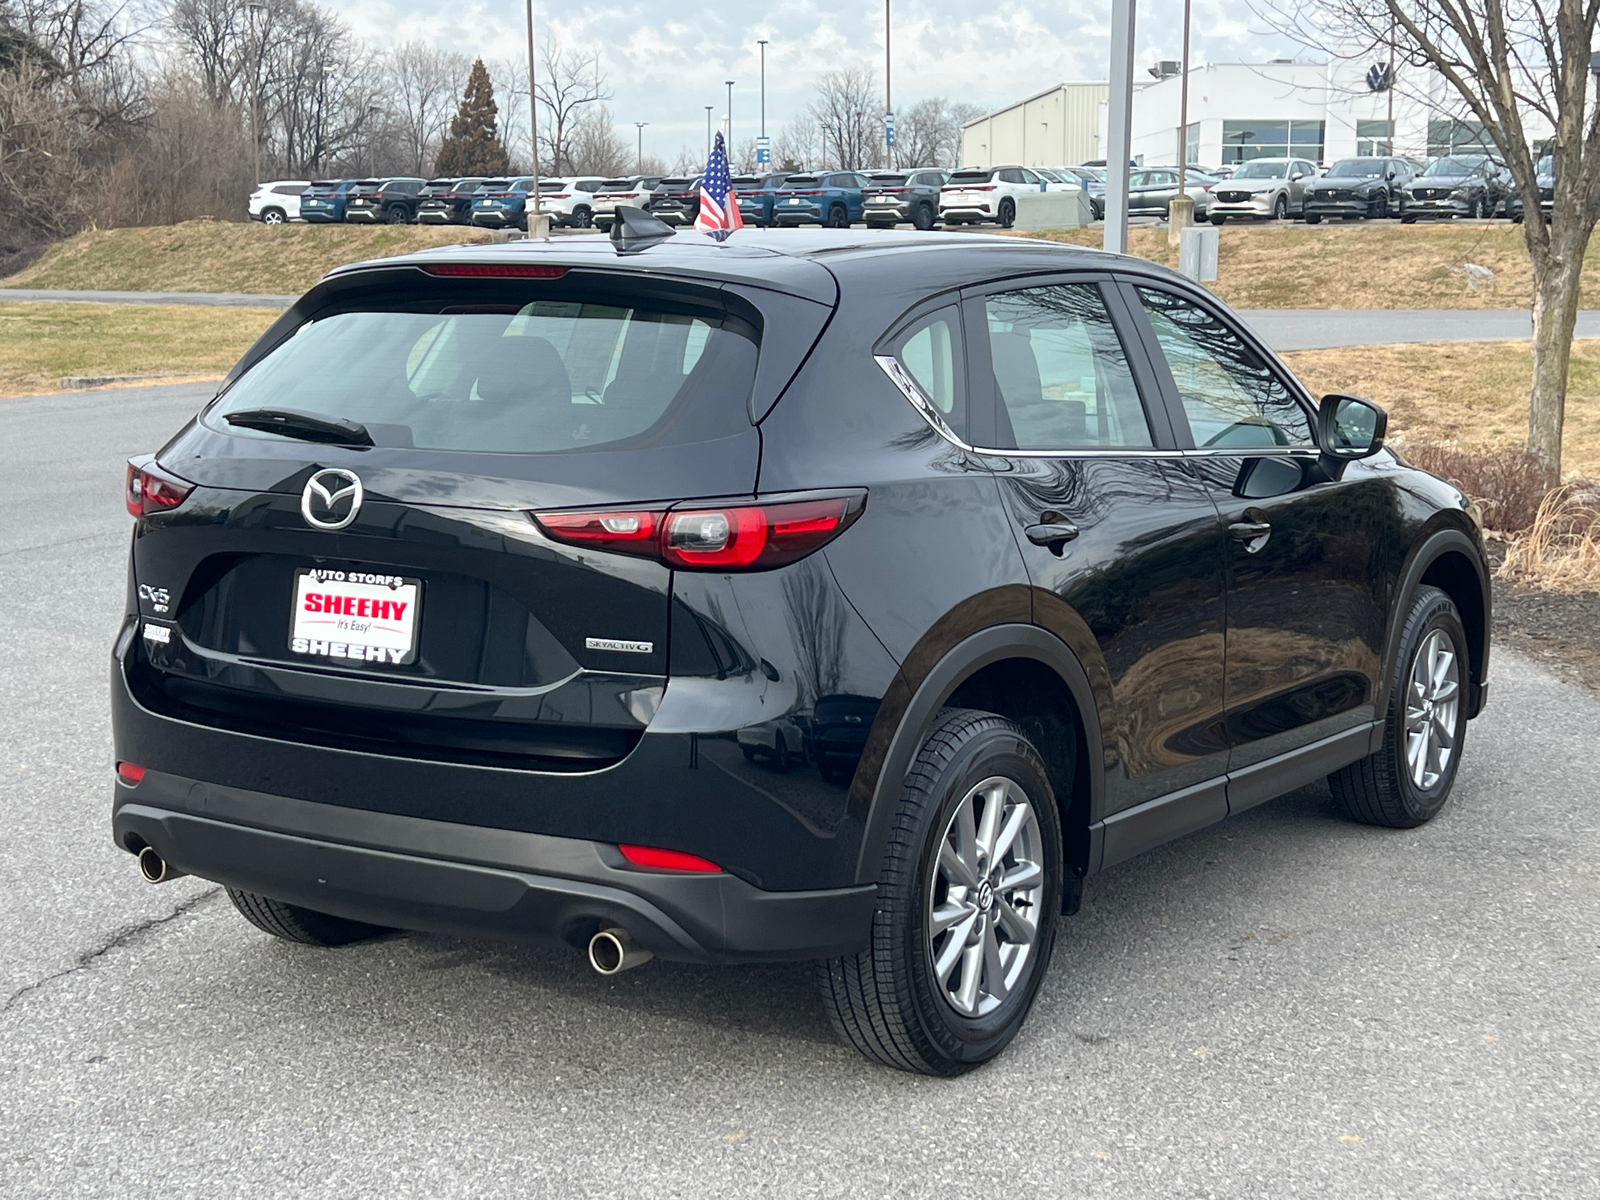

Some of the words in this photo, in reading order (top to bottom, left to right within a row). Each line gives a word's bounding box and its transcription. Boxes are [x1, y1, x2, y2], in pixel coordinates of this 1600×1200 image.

[308, 569, 345, 581] AUTO
[304, 592, 408, 621] SHEEHY
[337, 619, 349, 631] It's
[350, 620, 372, 634] Easy!
[292, 638, 409, 664] SHEEHY
